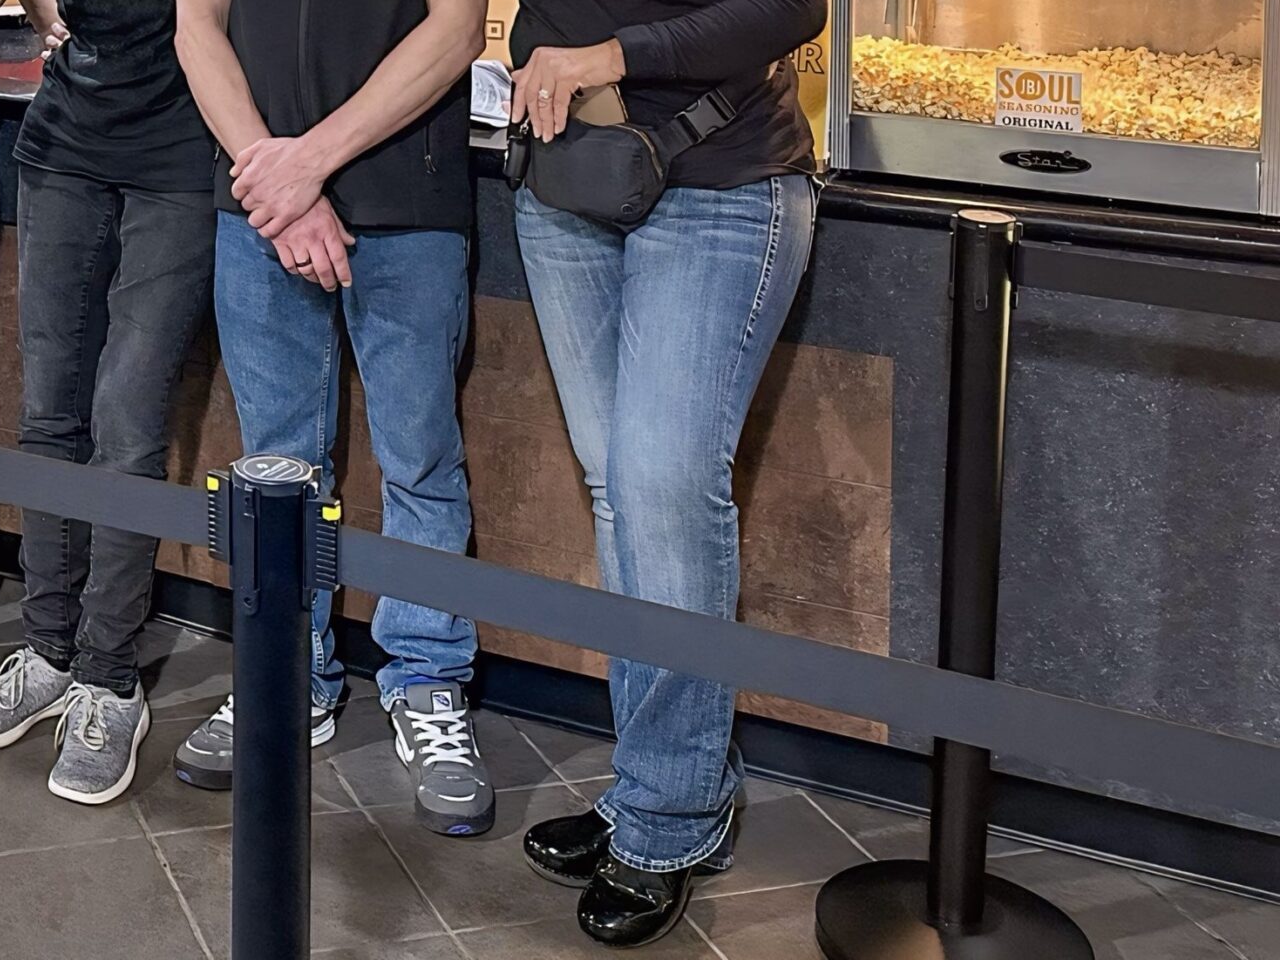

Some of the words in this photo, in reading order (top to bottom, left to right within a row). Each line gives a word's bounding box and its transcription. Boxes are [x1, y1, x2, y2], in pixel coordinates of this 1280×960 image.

[998, 70, 1081, 105] SOUL
[1020, 78, 1041, 96] JBJ
[998, 101, 1080, 116] SEASONING
[1002, 116, 1074, 132] ORIGINAL
